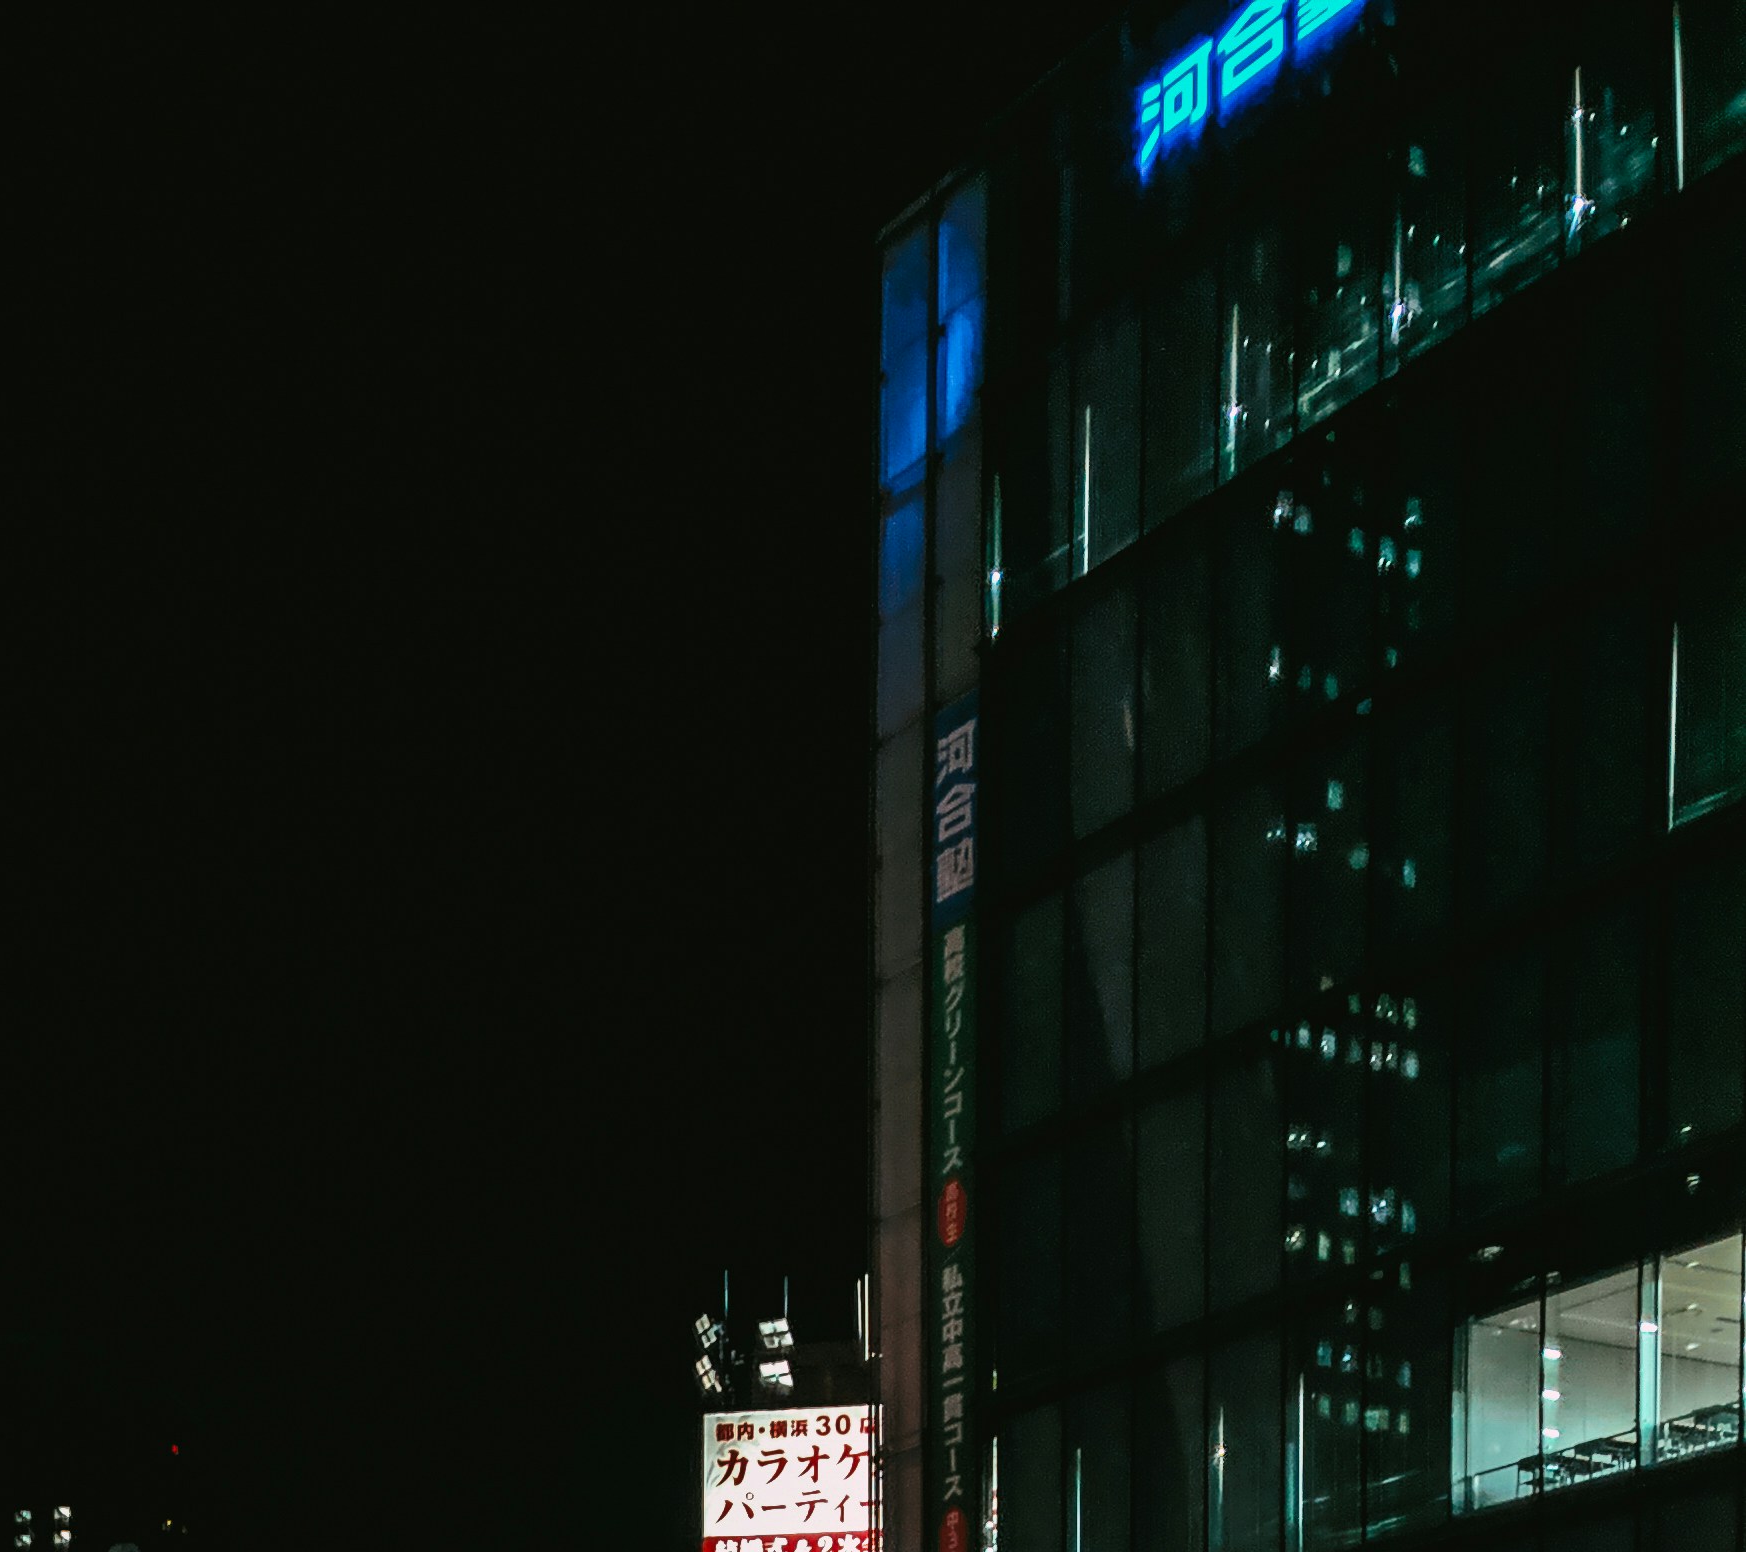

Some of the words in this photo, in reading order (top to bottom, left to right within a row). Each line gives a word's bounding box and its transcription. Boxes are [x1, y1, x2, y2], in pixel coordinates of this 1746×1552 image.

[936, 717, 978, 904] 河合塾
[715, 1443, 870, 1488] カラオケ
